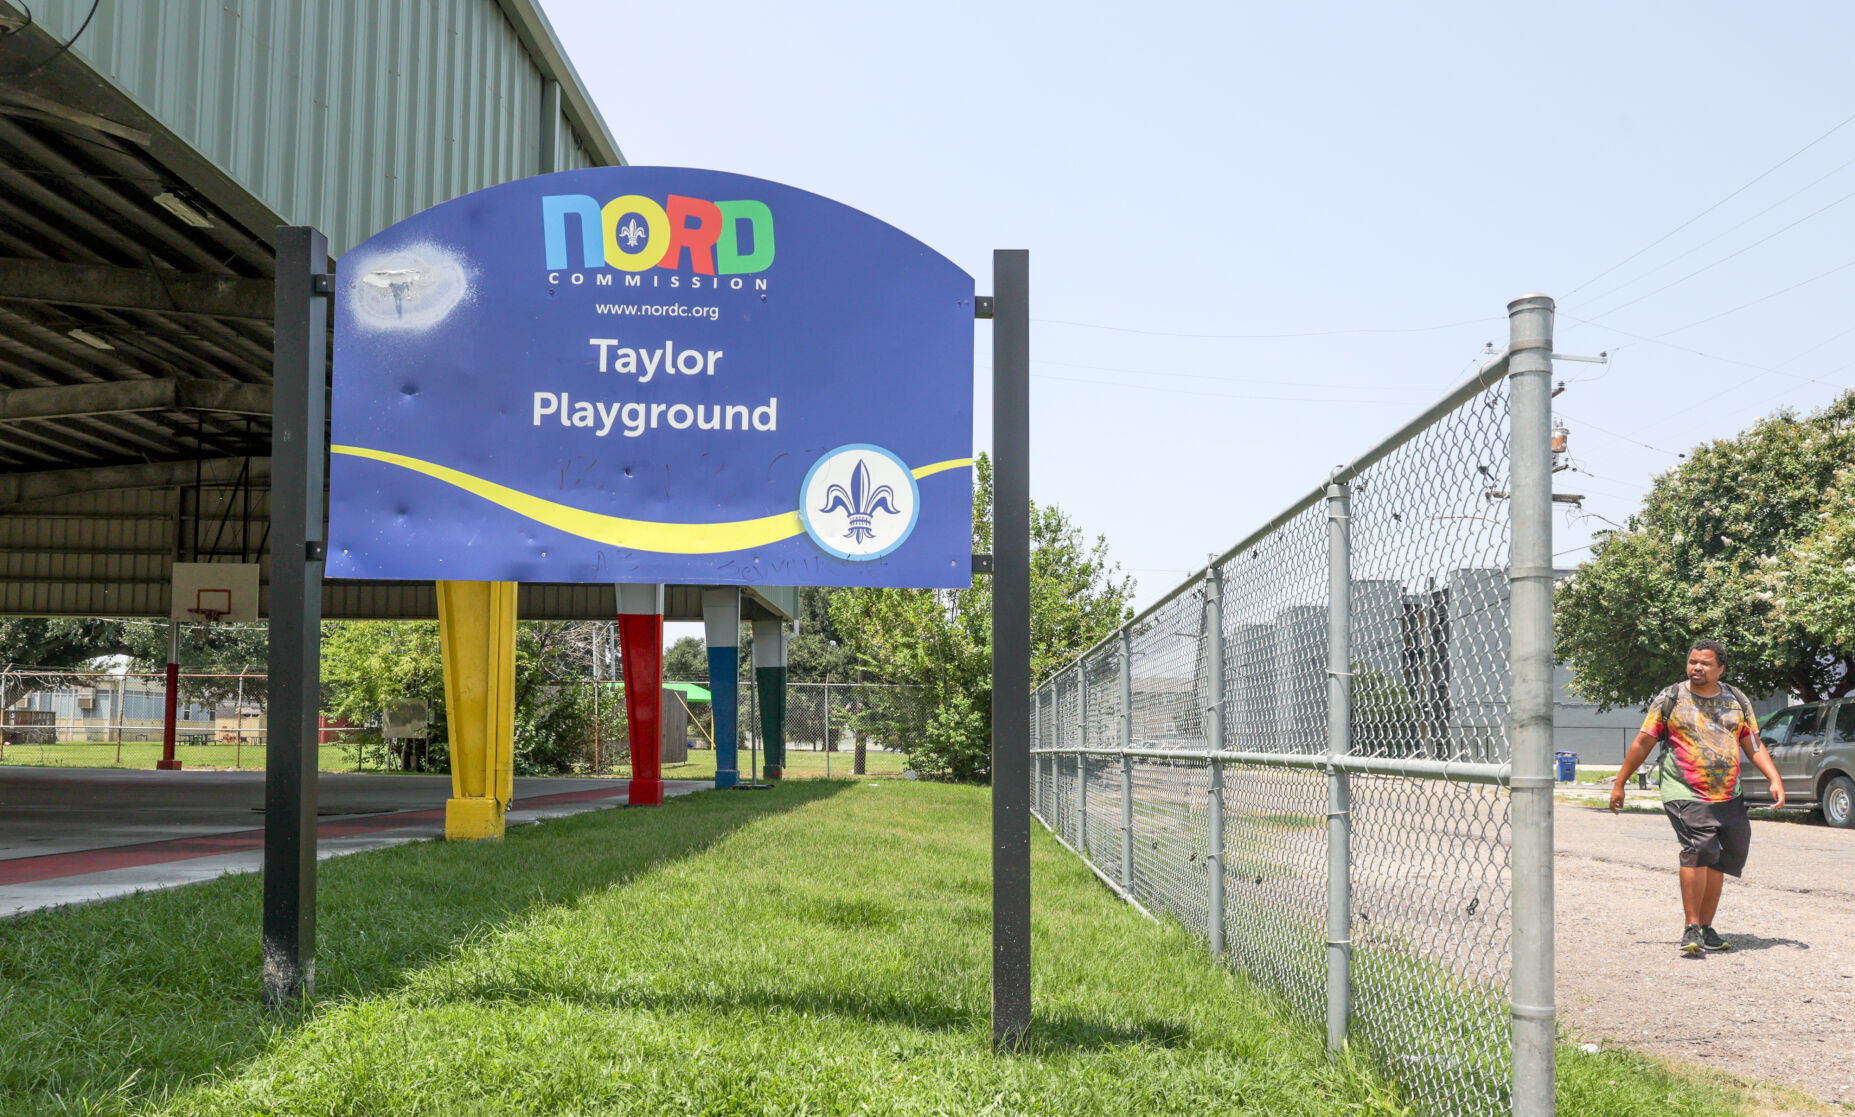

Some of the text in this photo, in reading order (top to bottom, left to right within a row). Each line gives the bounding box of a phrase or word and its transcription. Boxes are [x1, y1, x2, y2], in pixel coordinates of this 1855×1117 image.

[548, 272, 767, 290] COMMISSION
[595, 303, 719, 320] www.nordc.org
[589, 338, 723, 383] Taylor
[533, 391, 777, 437] Playground
